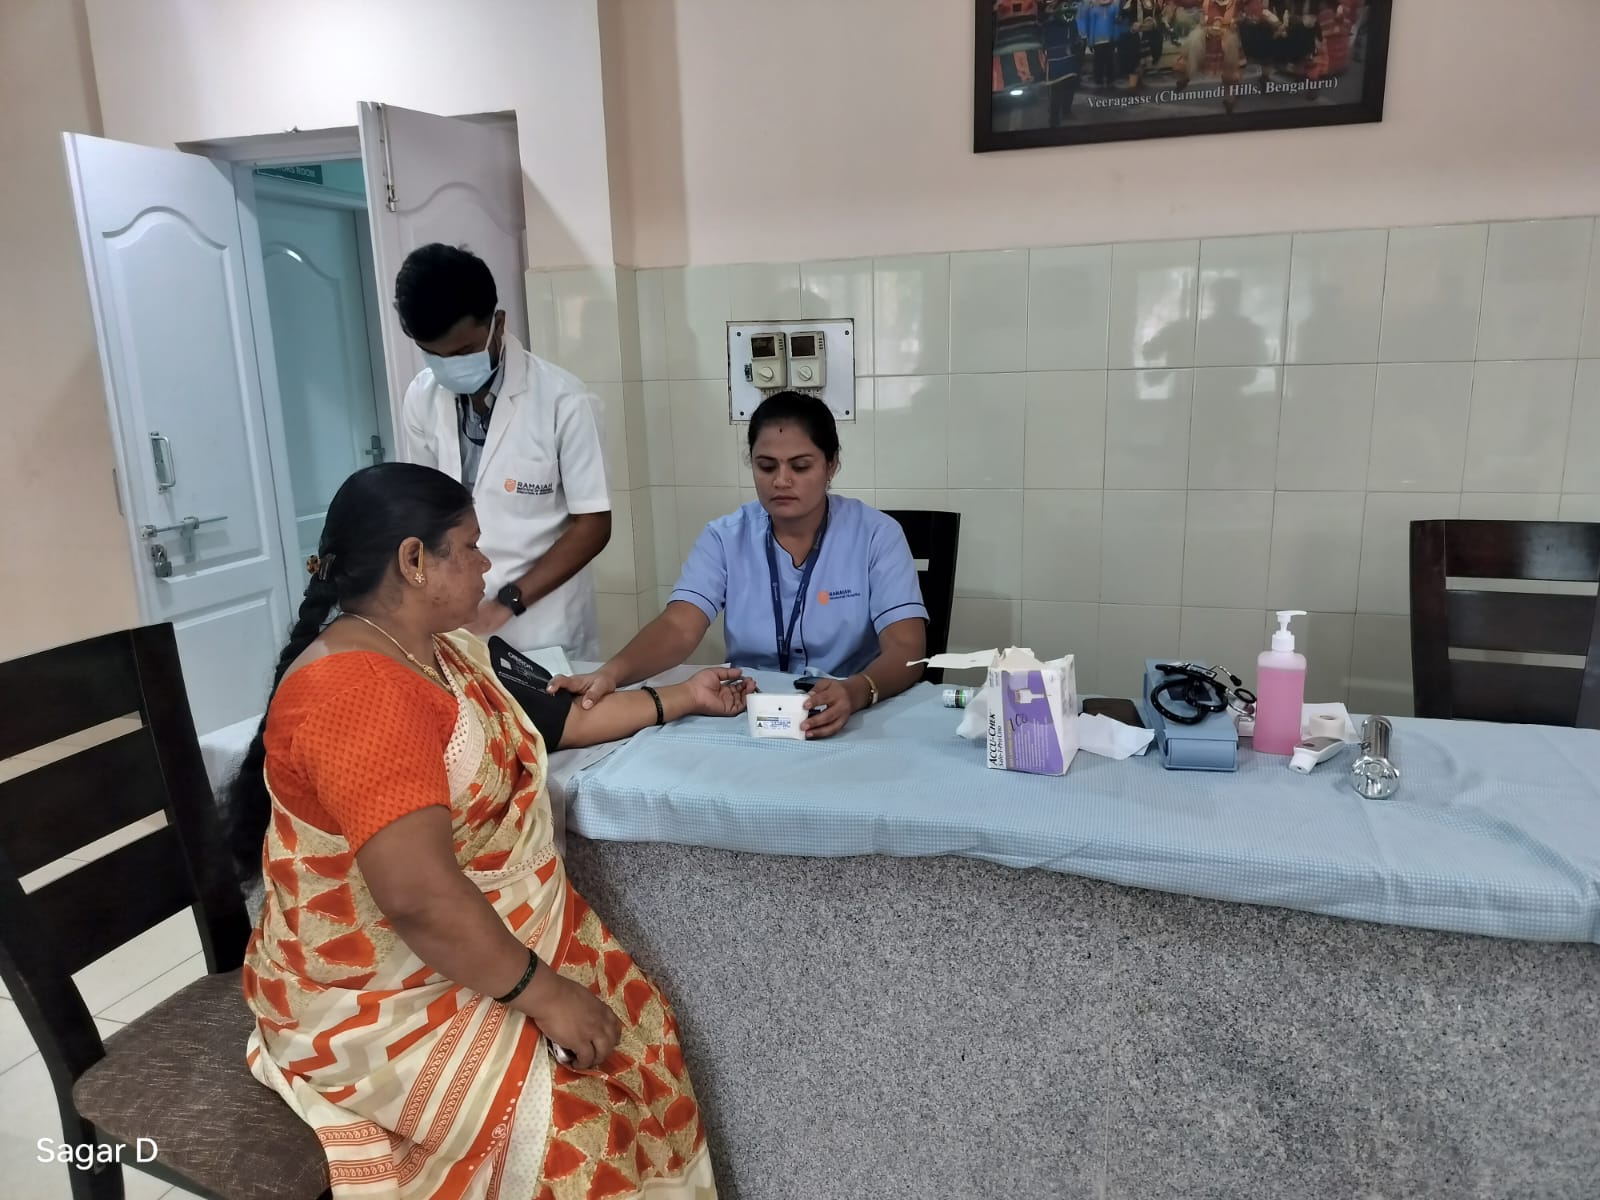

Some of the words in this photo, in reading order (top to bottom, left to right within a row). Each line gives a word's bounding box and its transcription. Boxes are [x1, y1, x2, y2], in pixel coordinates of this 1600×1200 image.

[1088, 95, 1152, 108] Veeragasse
[1155, 86, 1225, 104] (Chamundi
[1229, 84, 1262, 97] Hills,
[1265, 77, 1339, 94] Bengaluru)
[517, 481, 553, 490] RAMAIAH
[989, 713, 998, 766] ACCU-CHEK
